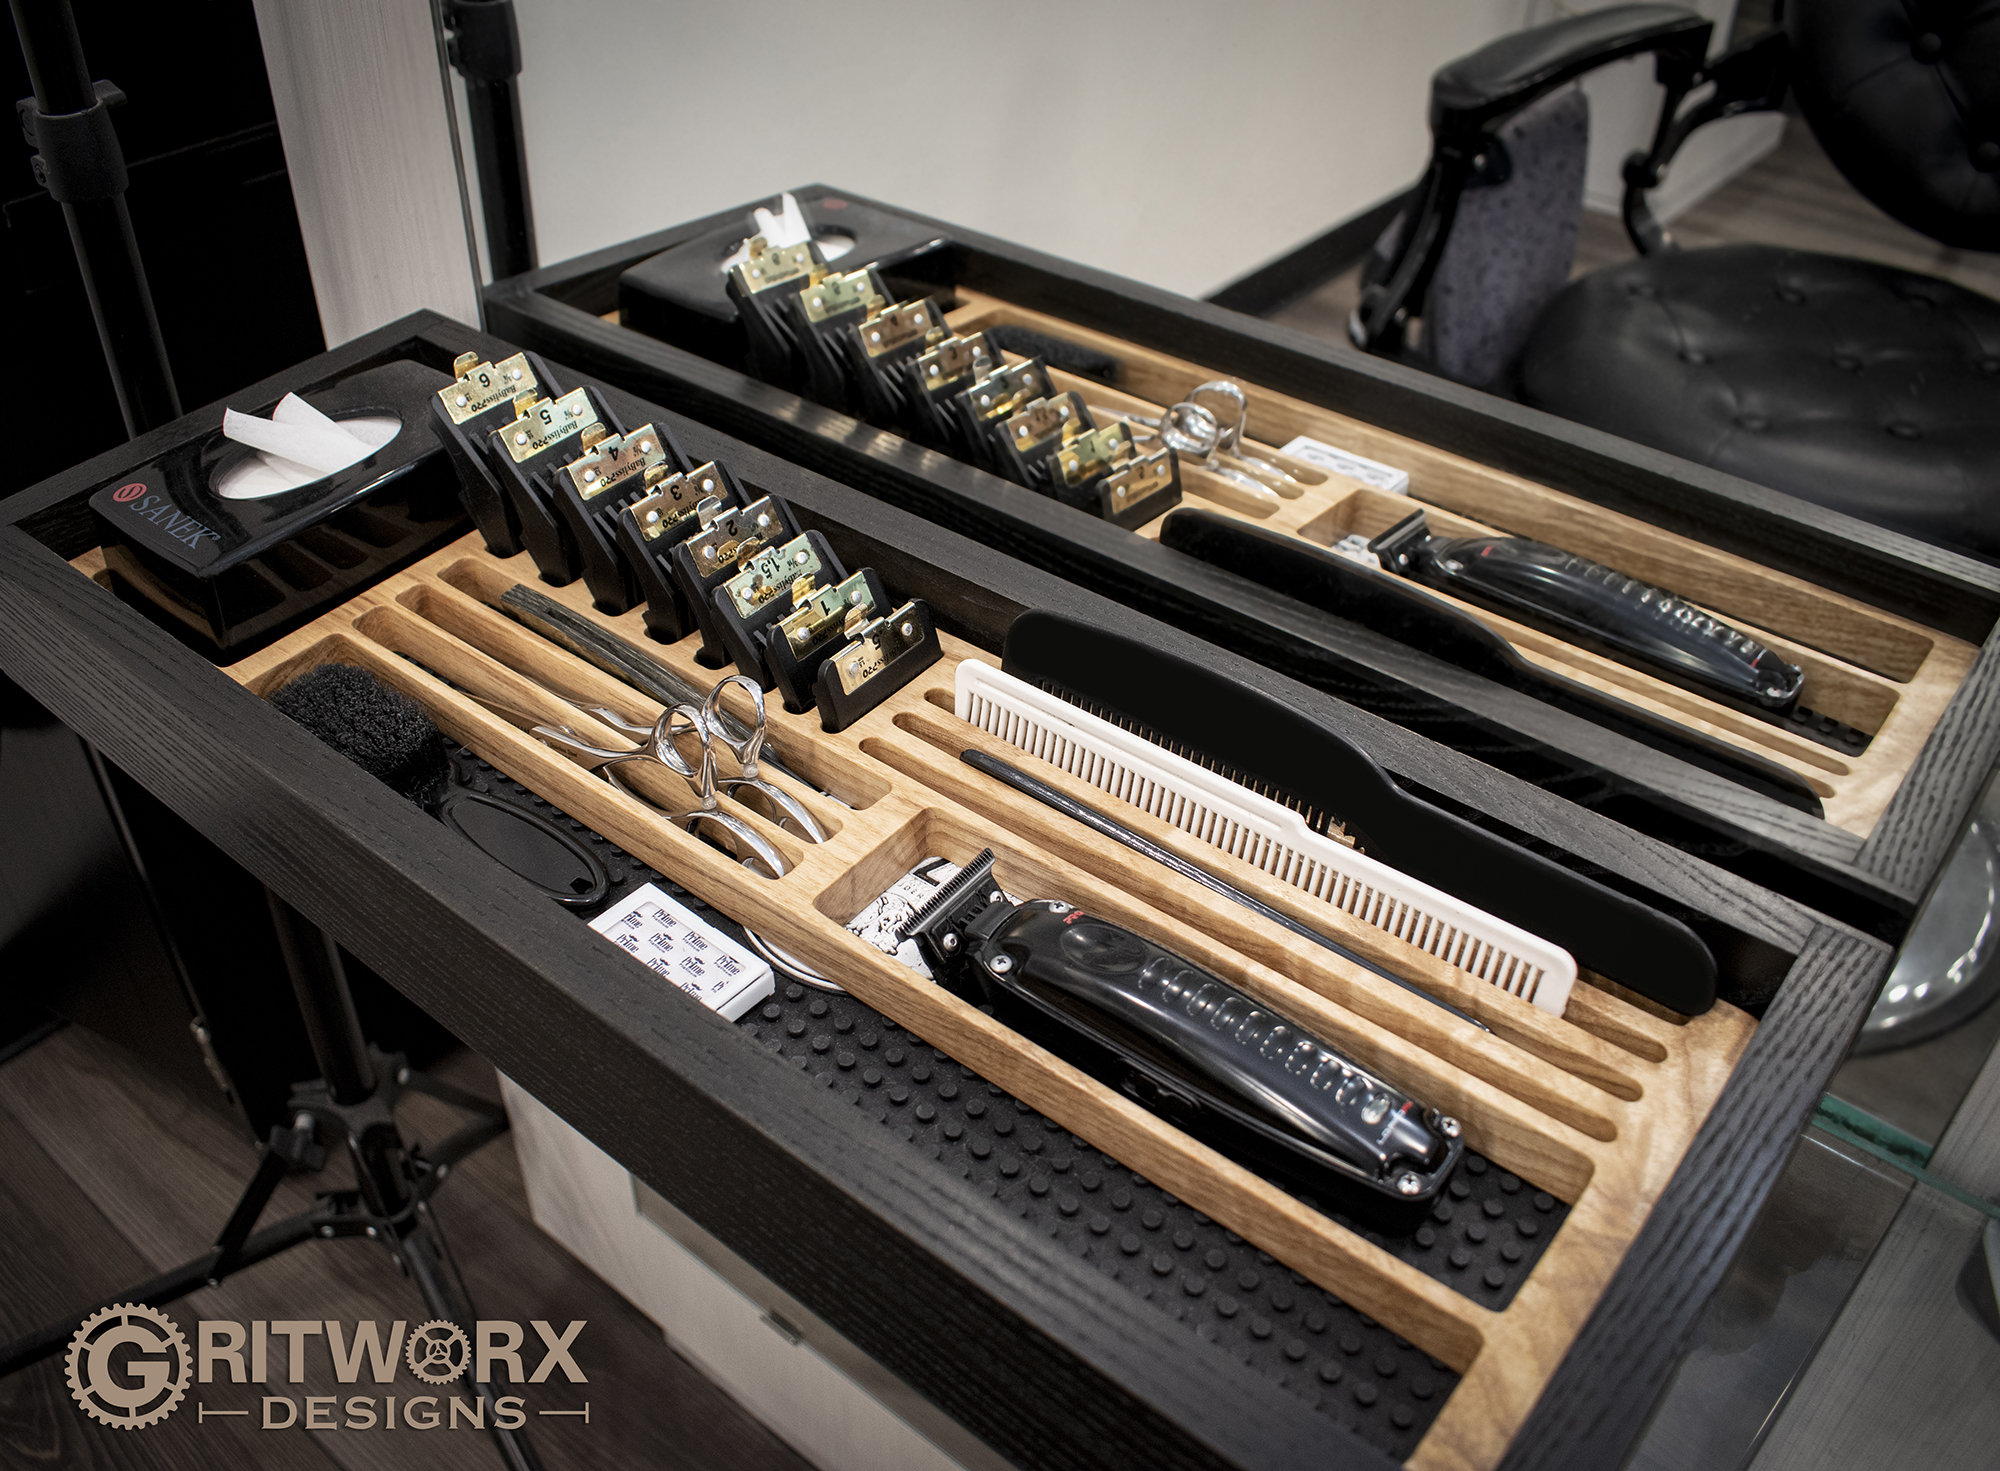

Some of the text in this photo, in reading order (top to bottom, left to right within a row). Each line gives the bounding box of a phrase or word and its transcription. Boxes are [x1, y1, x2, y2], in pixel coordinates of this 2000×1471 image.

[478, 372, 491, 388] 6
[471, 384, 517, 413] BaBylissPRO
[539, 408, 552, 425] 5
[532, 420, 578, 450] BaBylissPRO
[607, 446, 618, 461] 4
[599, 457, 646, 487] BaBylissPRO
[670, 484, 682, 501] 3
[129, 495, 219, 550] SANEK
[662, 496, 707, 529] BylissPRO
[725, 519, 738, 537] 2
[761, 557, 780, 580] 1.5
[820, 600, 831, 616] 1
